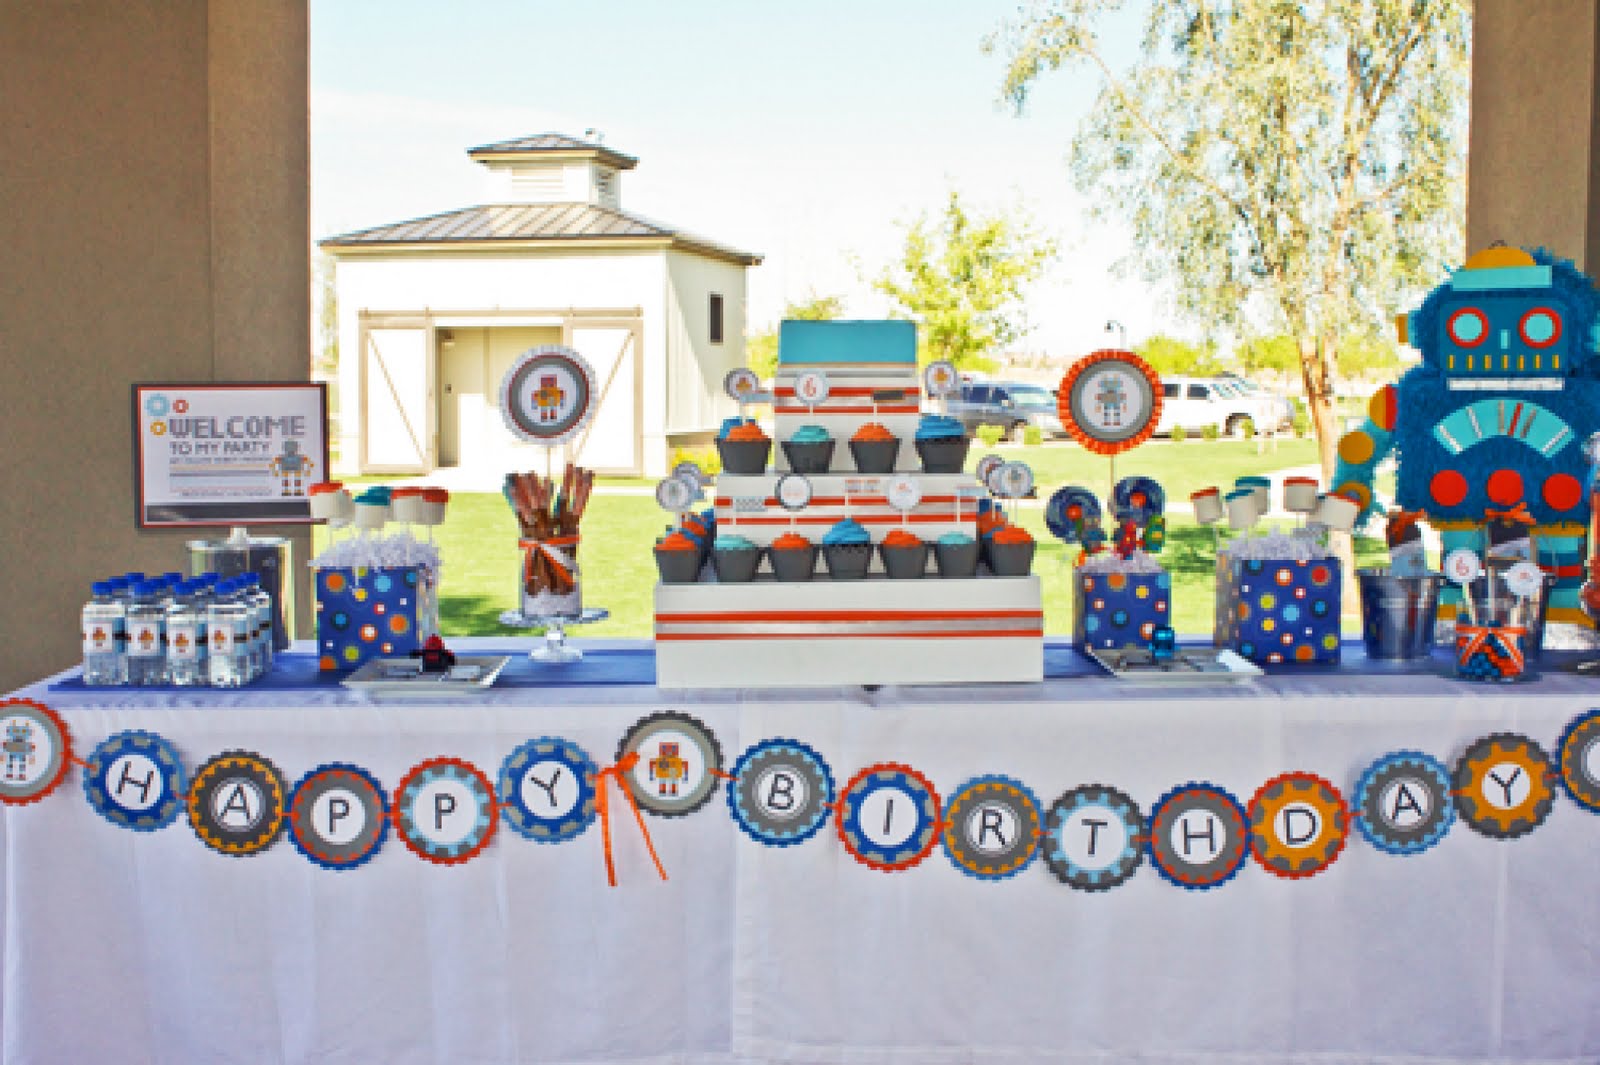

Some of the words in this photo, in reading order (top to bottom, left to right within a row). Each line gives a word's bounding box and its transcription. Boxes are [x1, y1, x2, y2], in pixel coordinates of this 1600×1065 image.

[169, 415, 305, 438] WELCOME
[169, 441, 192, 455] TO
[195, 441, 219, 455] MY
[223, 441, 271, 455] PARTY
[114, 760, 562, 836] HAPPY
[766, 767, 1522, 857] BIRTHDAY
